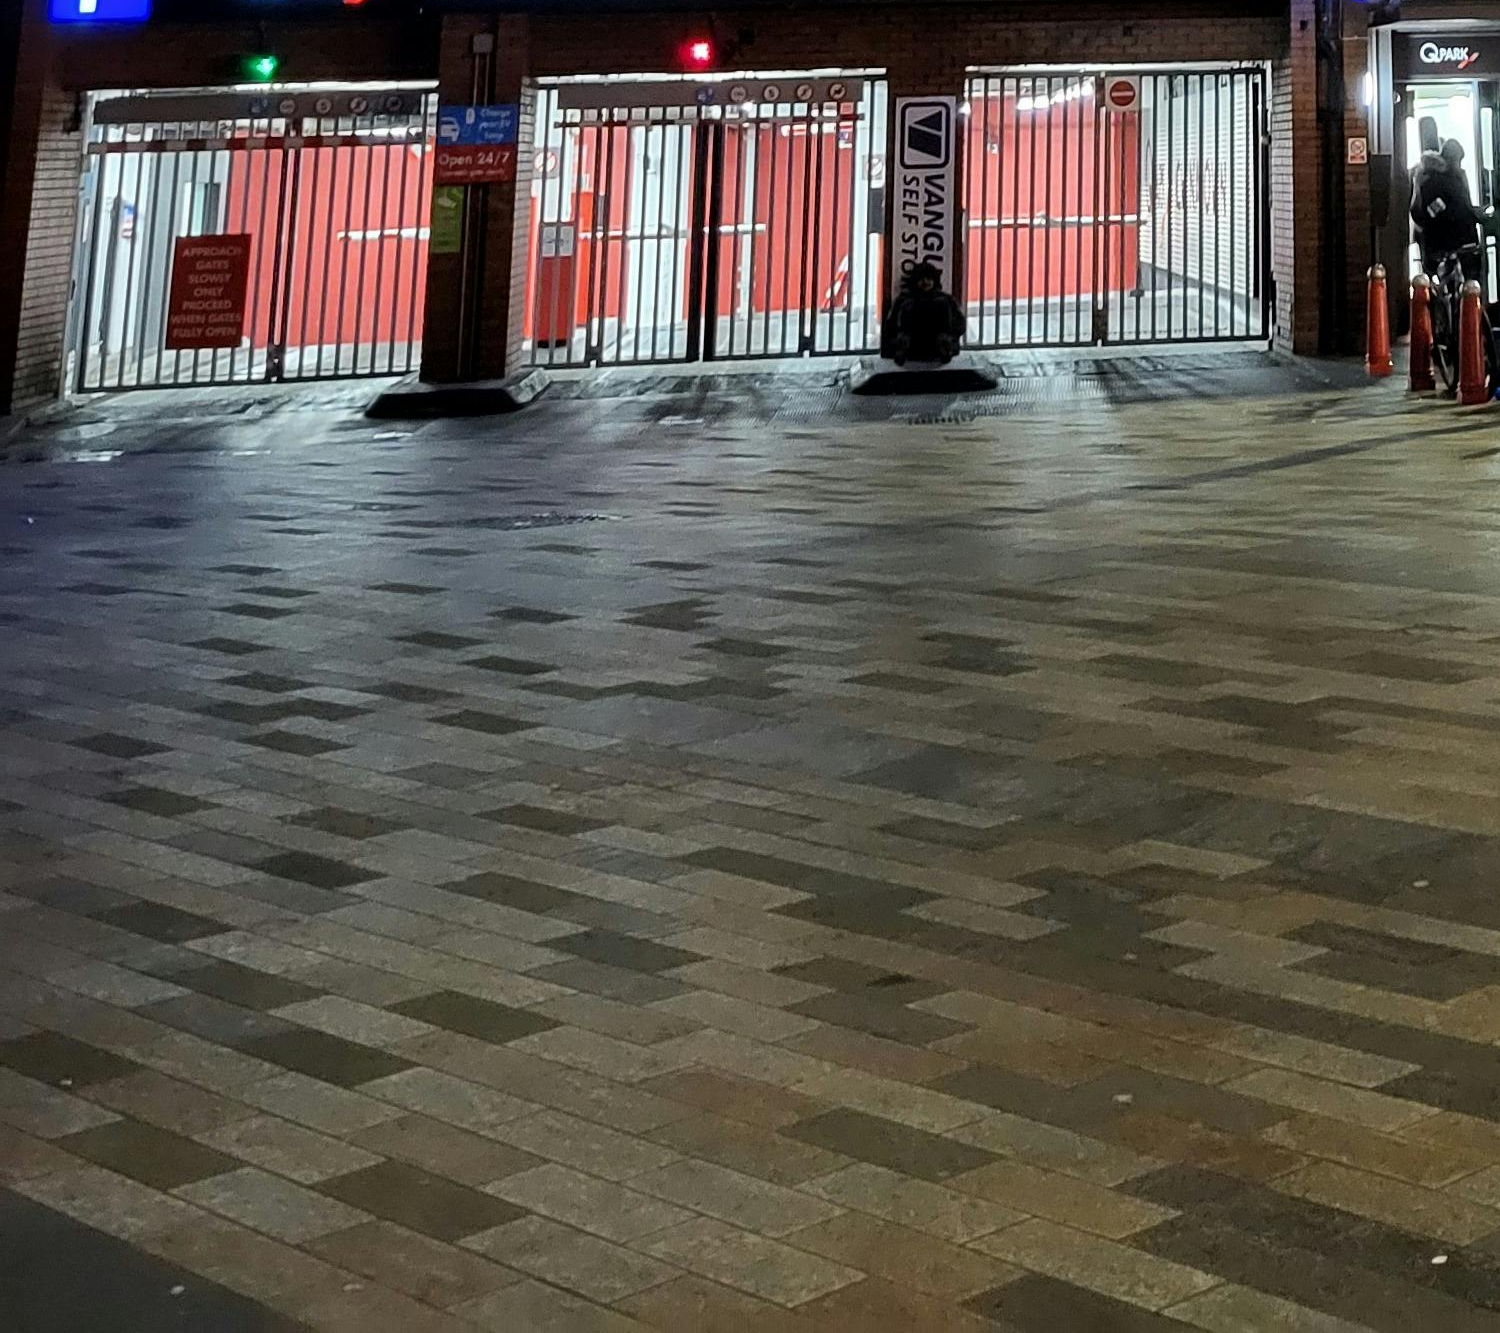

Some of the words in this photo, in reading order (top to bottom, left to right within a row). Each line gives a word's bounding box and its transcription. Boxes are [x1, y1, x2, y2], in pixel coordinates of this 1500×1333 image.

[439, 154, 472, 169] Open
[477, 151, 510, 165] 24/7
[902, 174, 920, 225] SELF
[923, 173, 945, 275] VANGU
[183, 247, 242, 257] APPROACH
[196, 260, 229, 270] GATES
[189, 273, 232, 284] SLOWLY
[193, 287, 225, 297] ONLY
[182, 300, 232, 310] PROCEED
[170, 314, 205, 324] WHEN
[173, 328, 203, 337] FULLY
[206, 327, 237, 336] OPEN
